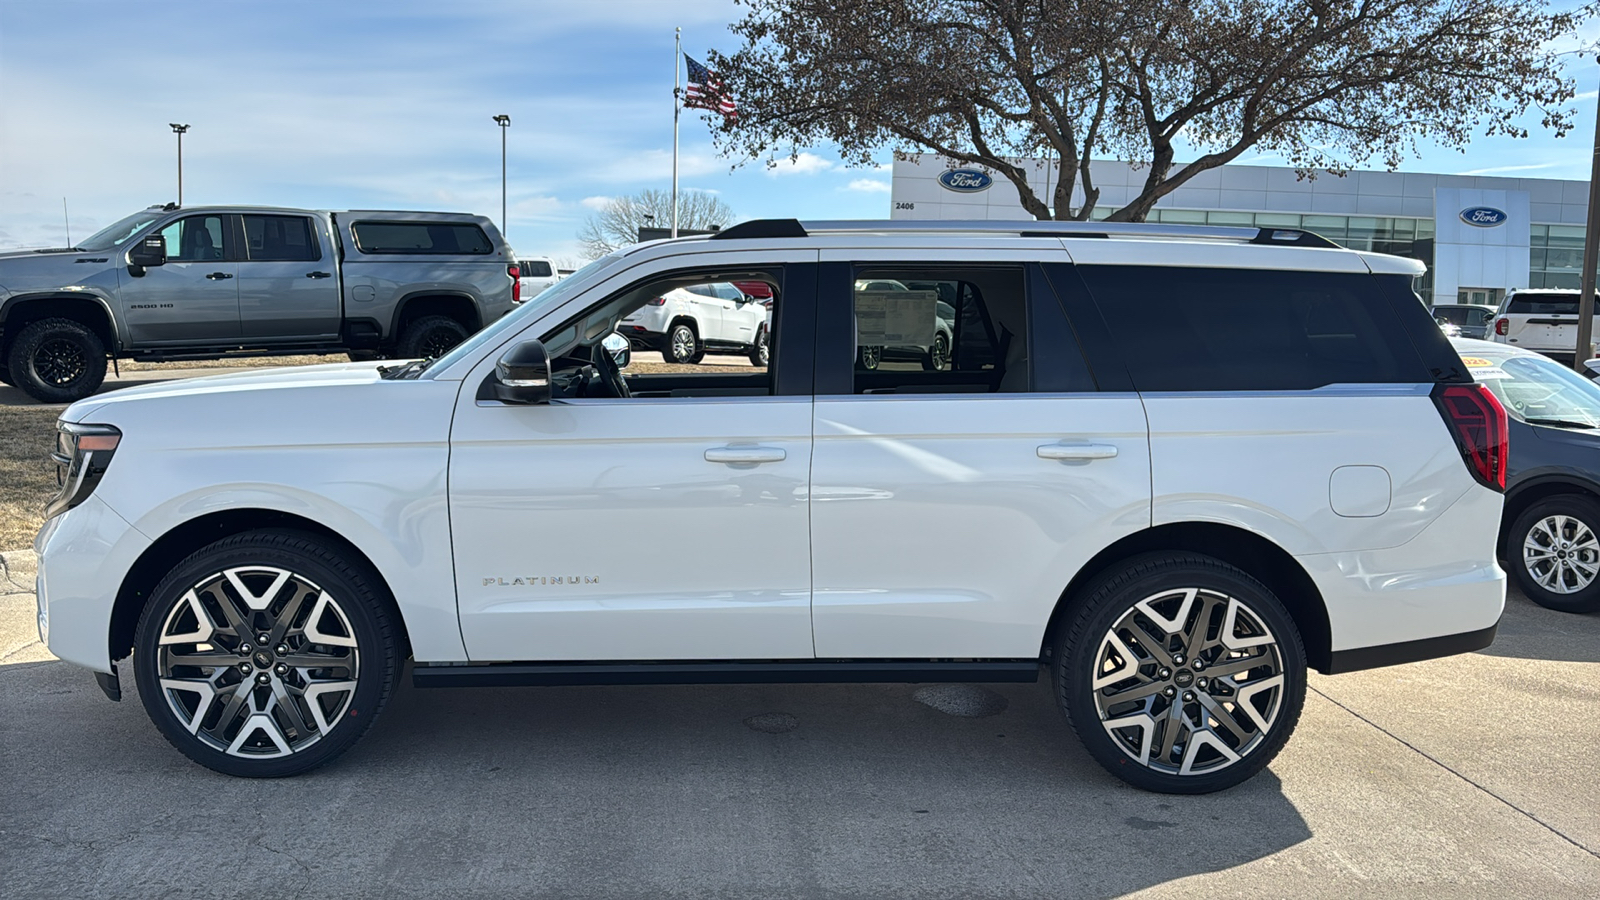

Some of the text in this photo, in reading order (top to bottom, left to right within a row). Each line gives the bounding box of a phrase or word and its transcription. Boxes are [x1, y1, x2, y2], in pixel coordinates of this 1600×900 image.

[950, 172, 982, 187] Ford
[895, 202, 915, 210] 2406
[1472, 210, 1498, 222] Ford
[483, 576, 599, 586] PLATINUM
